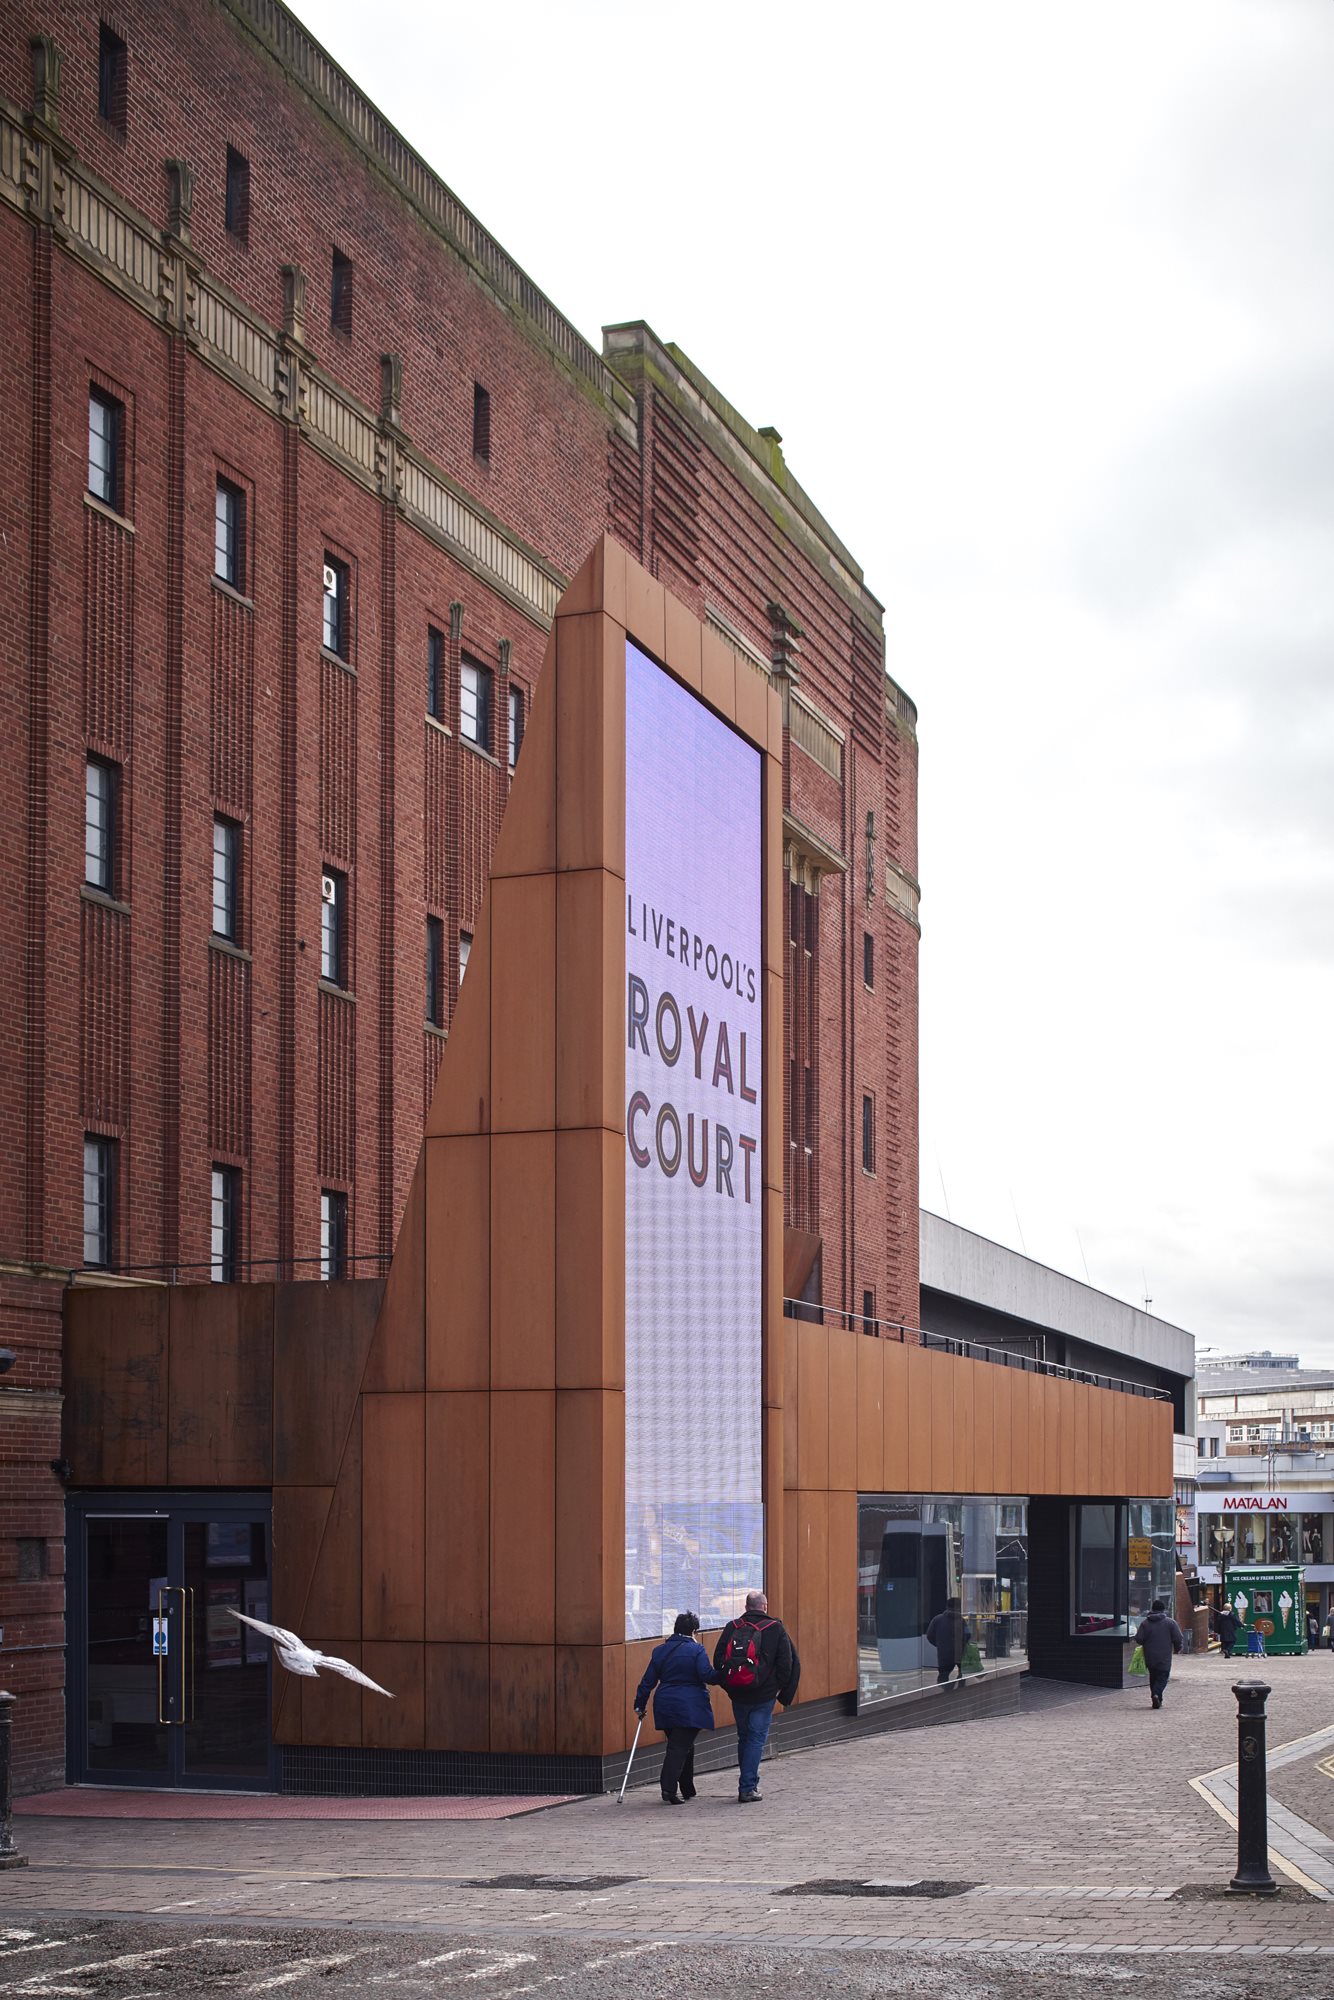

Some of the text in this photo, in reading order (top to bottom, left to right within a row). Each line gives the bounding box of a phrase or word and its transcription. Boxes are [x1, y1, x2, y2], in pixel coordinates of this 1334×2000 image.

[628, 894, 756, 1004] LIVERPOOL'S
[627, 972, 757, 1105] ROYAL
[626, 1090, 757, 1204] COURT
[1223, 1497, 1288, 1510] MATALAN
